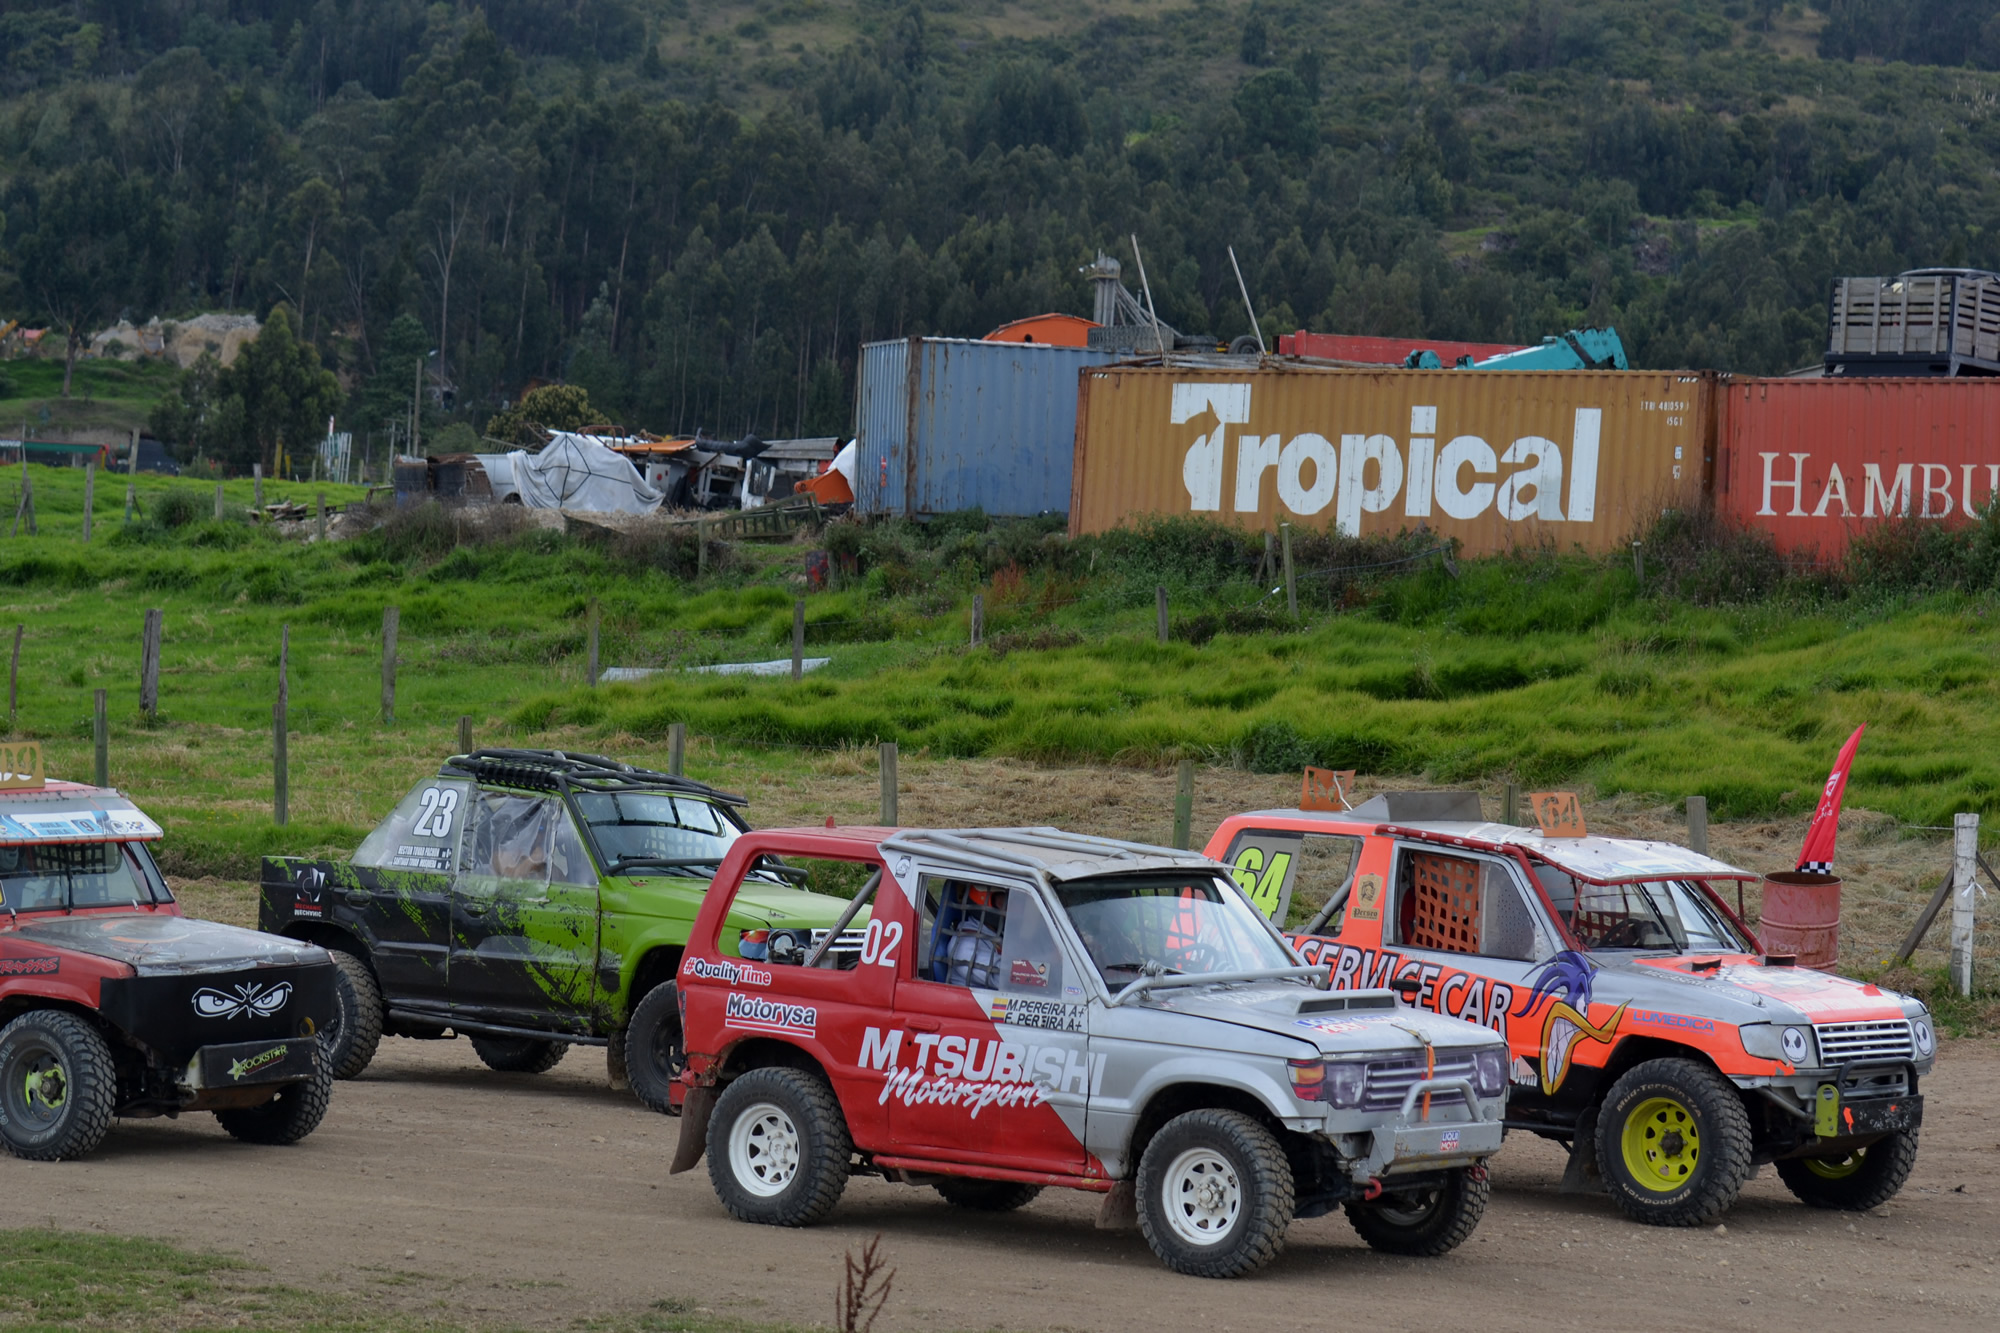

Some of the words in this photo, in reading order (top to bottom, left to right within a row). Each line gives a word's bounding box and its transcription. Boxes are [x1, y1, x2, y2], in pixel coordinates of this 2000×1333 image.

[1171, 383, 1602, 537] Tropical
[413, 787, 459, 838] 23
[1541, 796, 1579, 830] 64
[861, 919, 903, 967] 02
[683, 957, 771, 985] #QualityTime
[726, 992, 816, 1027] Motorysa
[1066, 1018, 1082, 1031] A+
[1069, 1005, 1084, 1017] A+
[1633, 1010, 1714, 1032] LUMEDICA
[878, 1065, 1054, 1119] Motorsports
[1622, 1182, 1692, 1206] BFGoodrich
